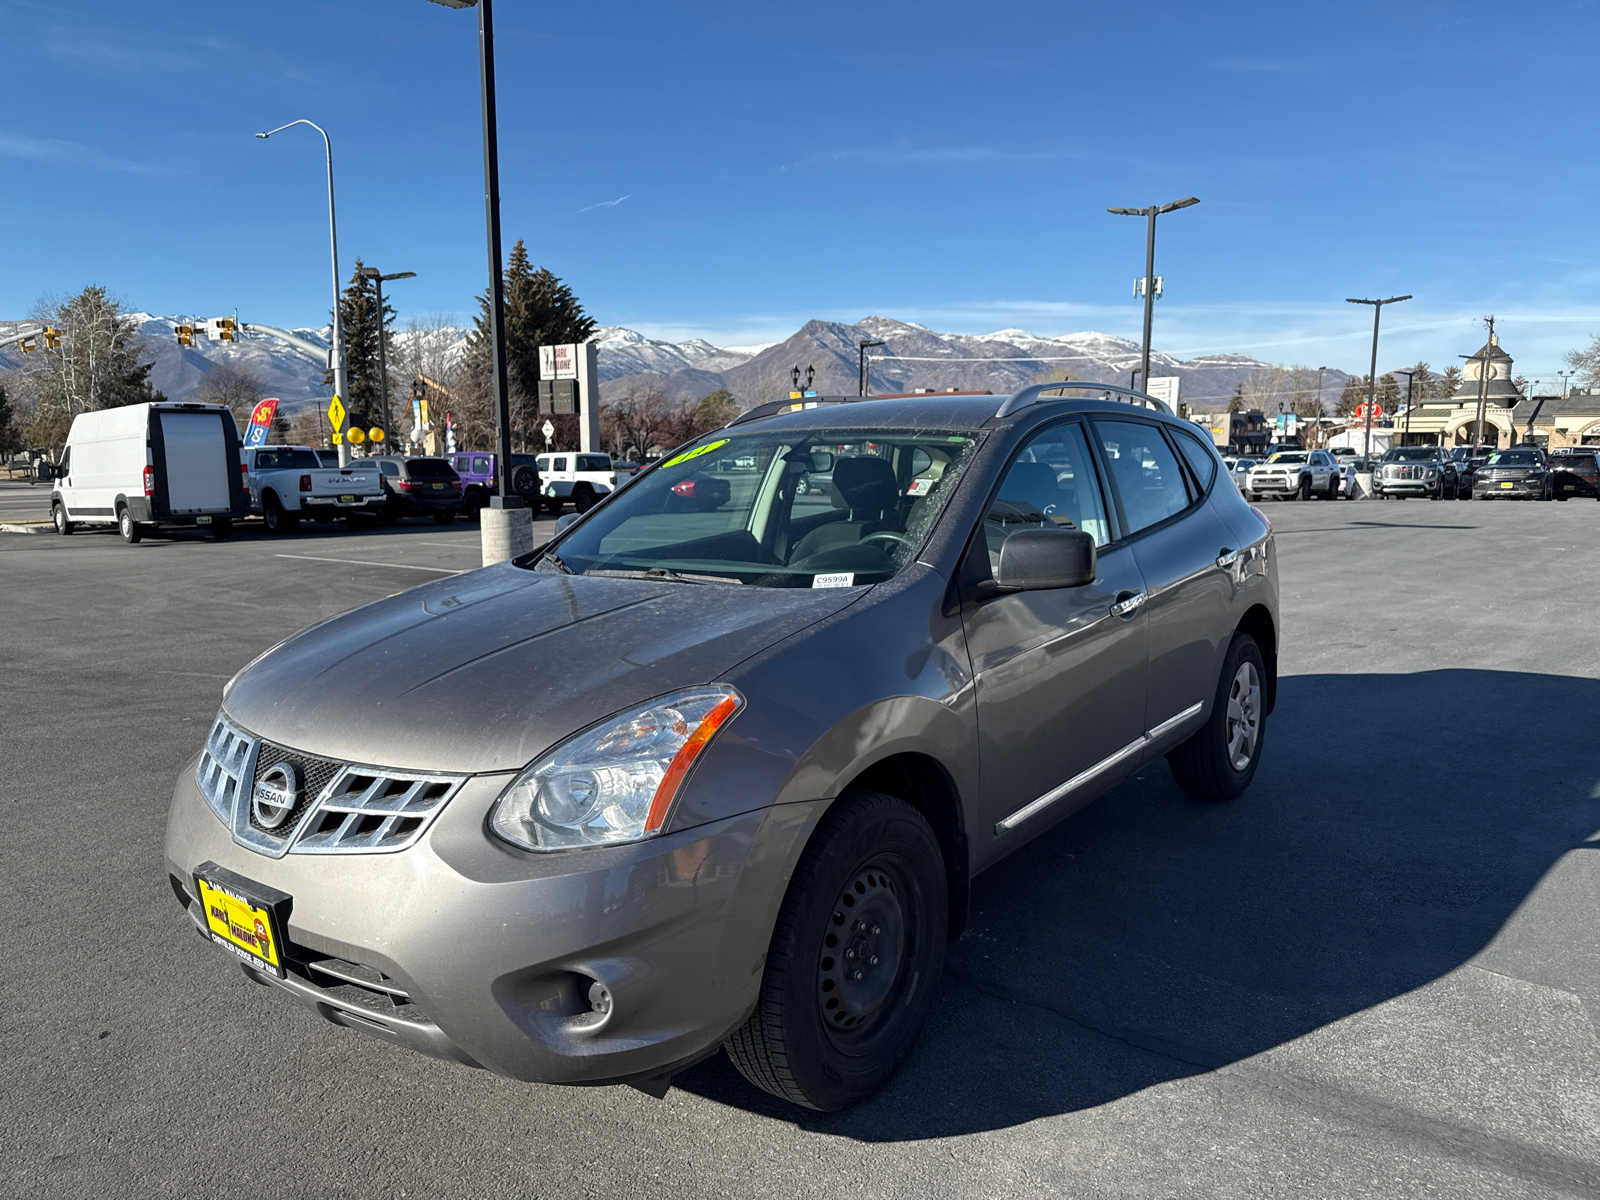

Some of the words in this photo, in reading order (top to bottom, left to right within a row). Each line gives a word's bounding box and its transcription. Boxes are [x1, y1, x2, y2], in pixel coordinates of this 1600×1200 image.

[816, 575, 848, 584] C9599A
[210, 904, 227, 923] KARL
[230, 923, 258, 948] MALONE
